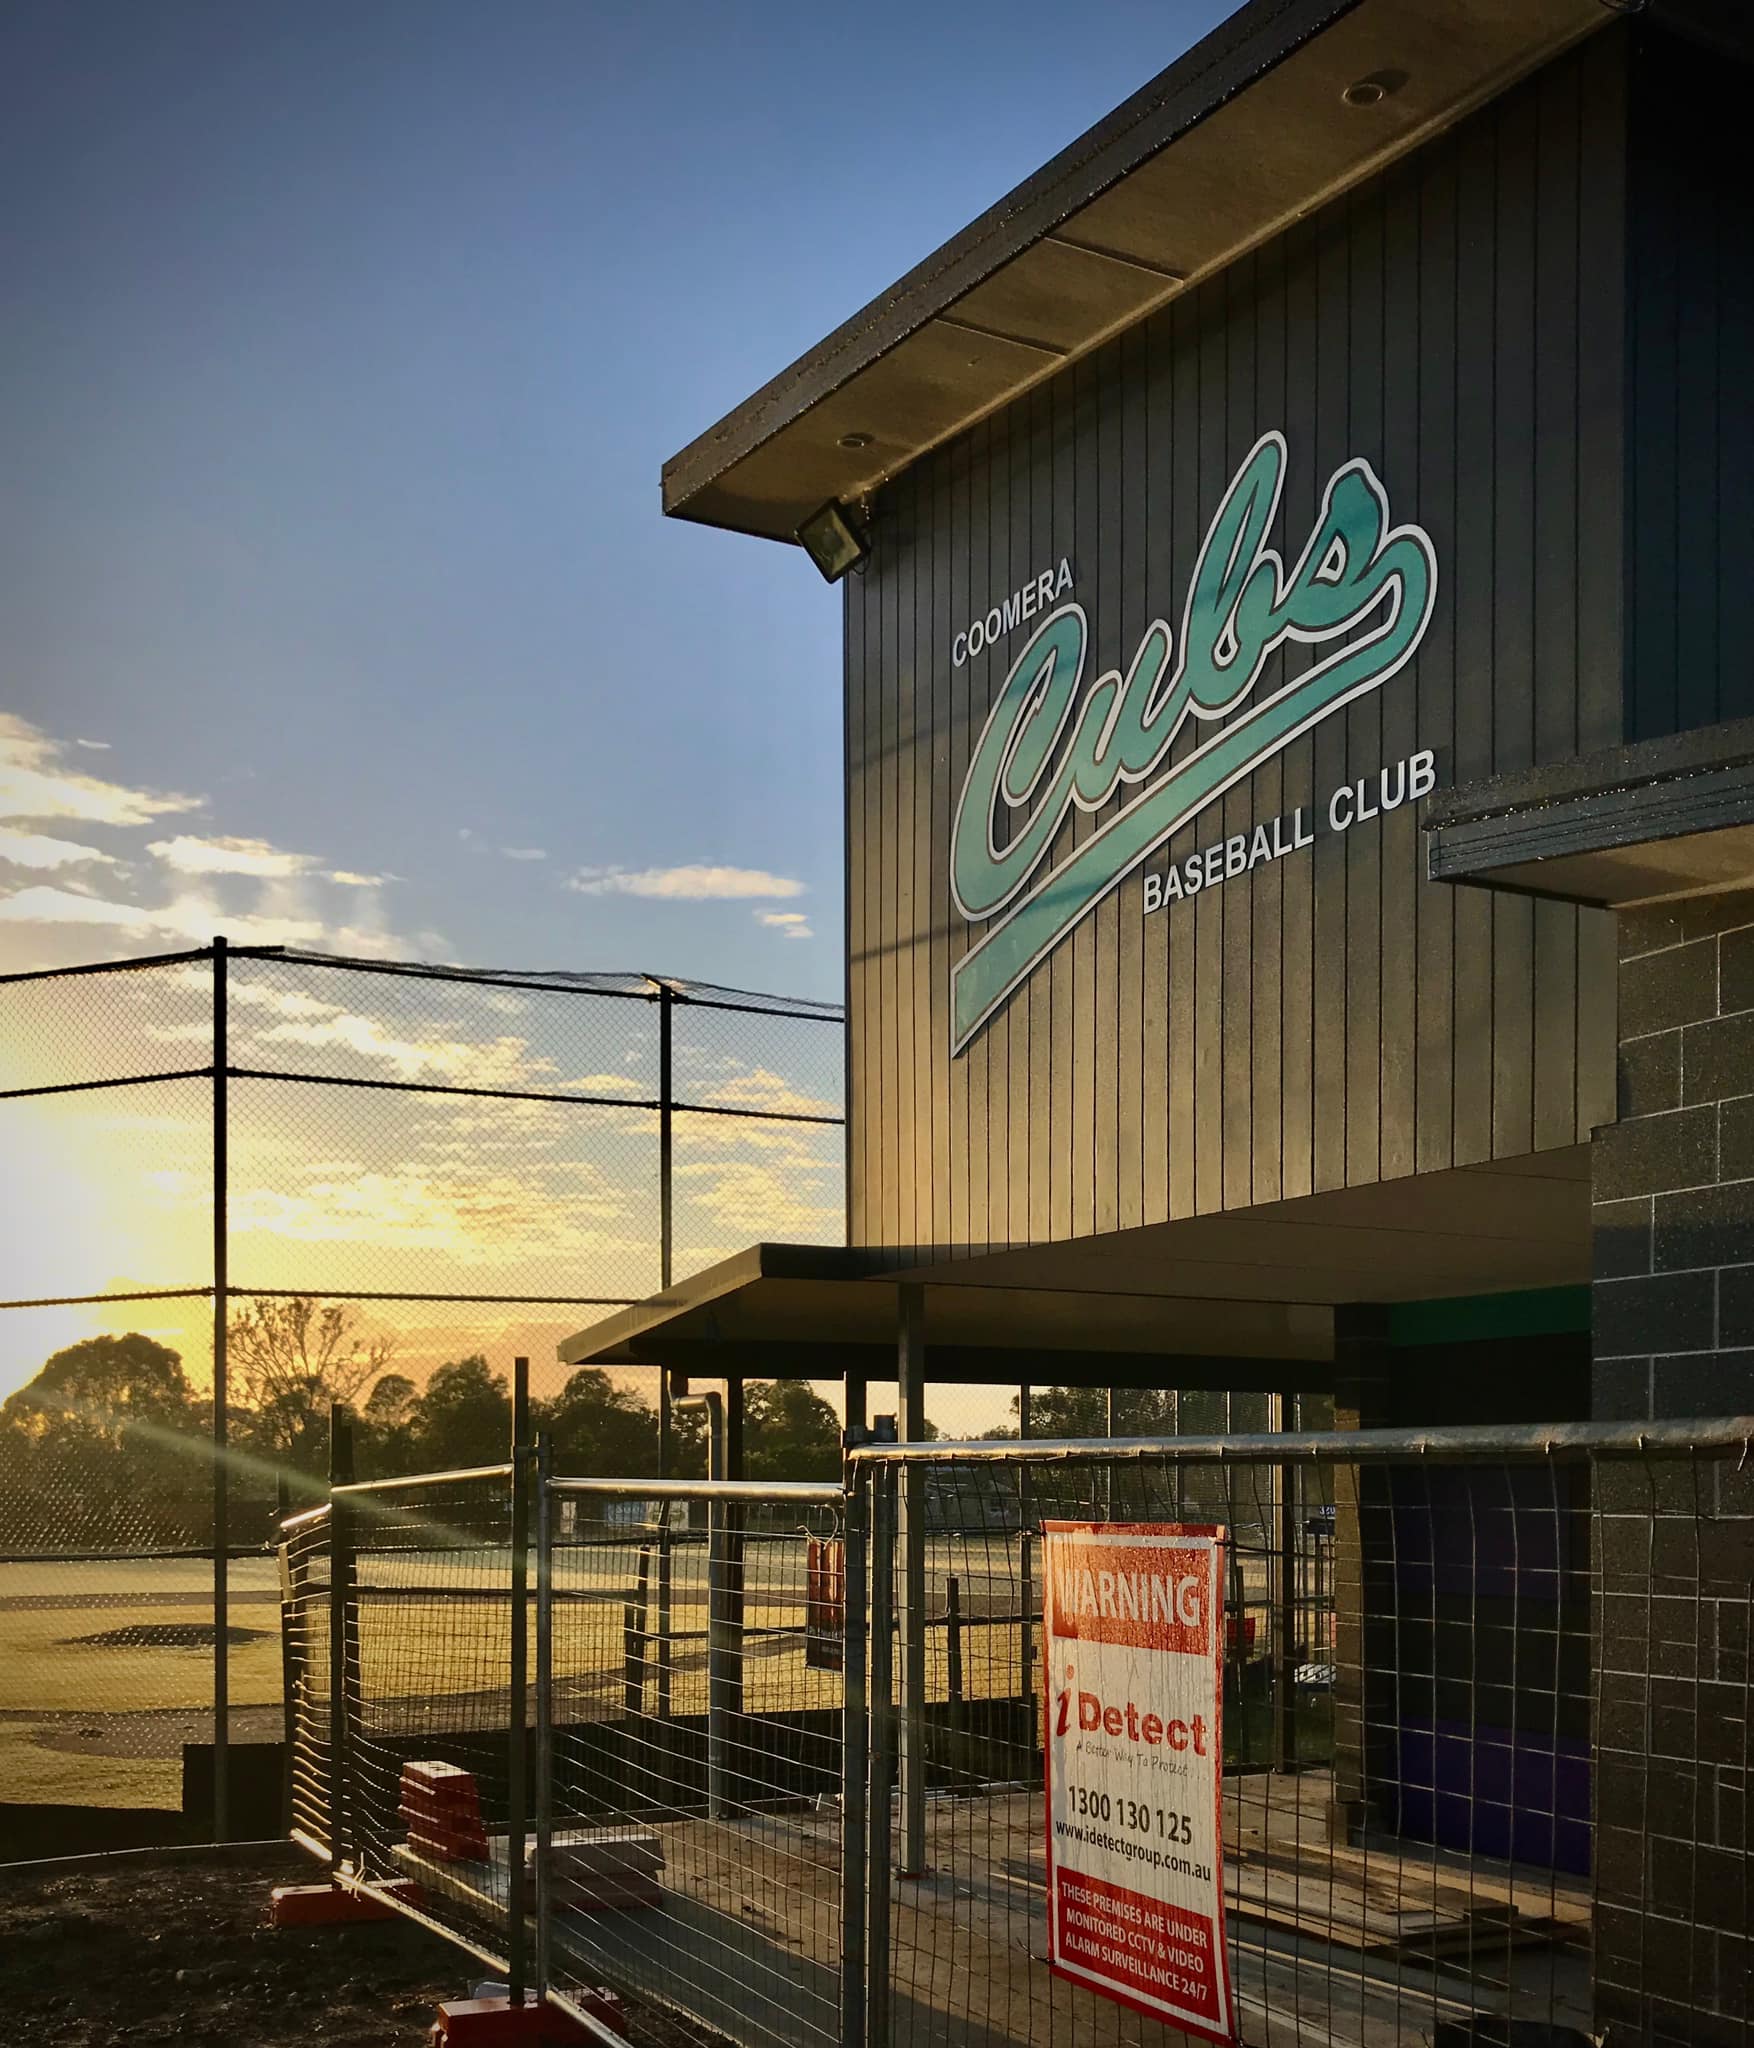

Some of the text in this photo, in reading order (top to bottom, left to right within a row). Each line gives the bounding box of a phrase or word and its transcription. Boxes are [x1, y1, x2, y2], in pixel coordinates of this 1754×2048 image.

[953, 557, 1074, 667] COOMERA
[951, 431, 1438, 1058] Cubs
[1143, 750, 1436, 915] BASEBALL CLUB
[1054, 1567, 1201, 1627] WARNING
[1137, 1754, 1148, 1767] To
[1068, 1785, 1192, 1846] 1300 130 125
[1056, 1820, 1211, 1882] www.idetectgroup.com.au
[1061, 1881, 1208, 1949] THESE PREMISES ARE UNDER
[1066, 1907, 1204, 1974] MONITORED CCTV & VIDEO
[1065, 1932, 1208, 2001] ALARM SURVEILLANCE 24/7
